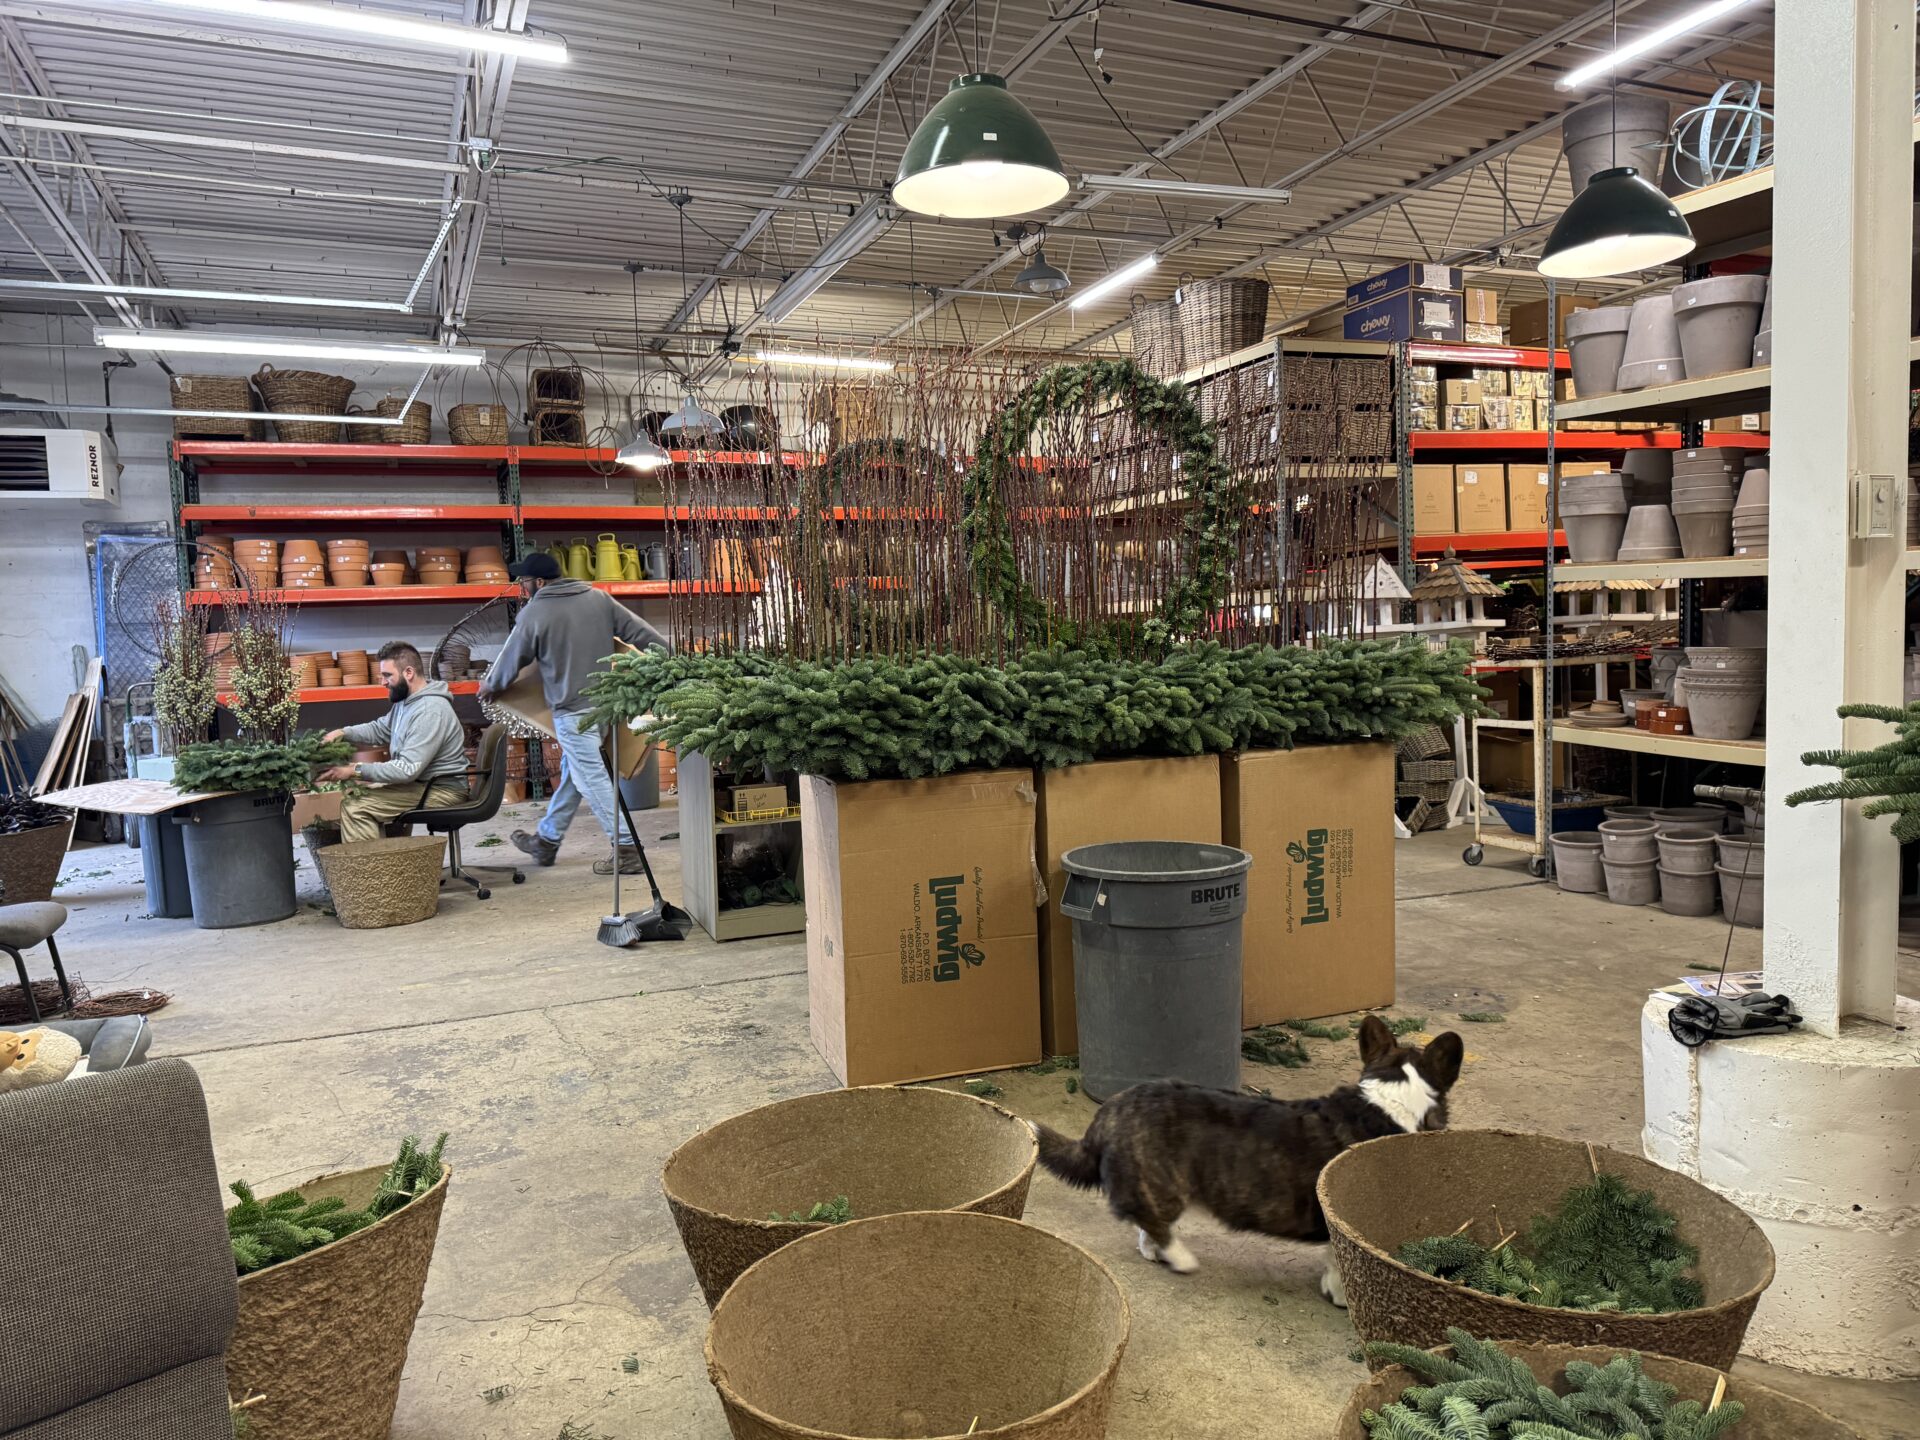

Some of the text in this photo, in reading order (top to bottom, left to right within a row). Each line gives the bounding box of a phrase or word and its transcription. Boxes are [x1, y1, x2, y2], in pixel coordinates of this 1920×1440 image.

[1366, 278, 1388, 291] chewy
[1360, 314, 1391, 333] chewy
[88, 445, 99, 487] REZNOR
[1191, 883, 1240, 904] BRUTE
[1301, 829, 1329, 926] Ludwig
[914, 916, 922, 958] ARKANSAS
[929, 874, 964, 982] Ludwig
[900, 928, 908, 984] 1-870-693-5565
[907, 928, 915, 983] 1-800-530-7792
